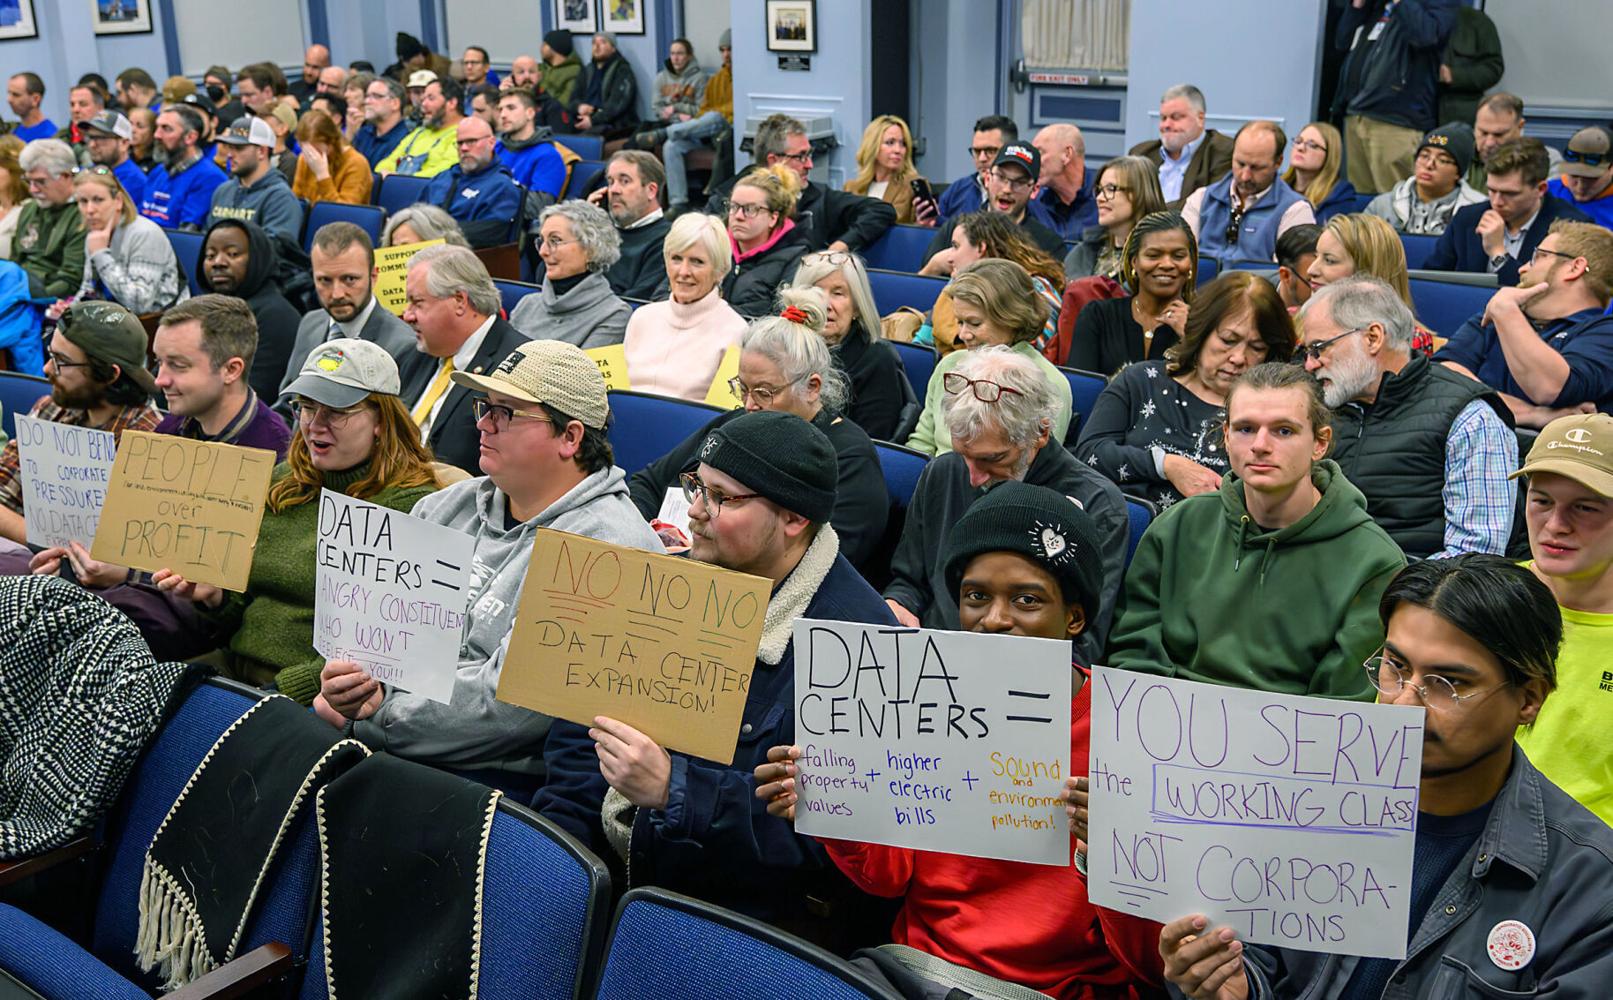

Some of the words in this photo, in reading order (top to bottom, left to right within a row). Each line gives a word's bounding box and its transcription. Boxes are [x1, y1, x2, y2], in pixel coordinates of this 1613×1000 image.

[382, 287, 404, 296] DATA
[20, 418, 44, 446] DO
[53, 425, 82, 457] NOT
[1547, 440, 1604, 456] Champion
[26, 458, 38, 475] TO
[57, 465, 108, 482] CORPORATE
[122, 435, 261, 503] PEOPLE
[158, 500, 202, 520] over
[320, 495, 393, 551] DATA
[121, 519, 246, 576] PROFIT
[318, 538, 423, 590] CENTERS
[321, 573, 372, 615] ANGRY
[379, 593, 465, 631] CONSTITUEN
[553, 540, 622, 600] NO
[640, 562, 691, 616] NO
[702, 579, 758, 629] NO
[536, 619, 638, 665] DATA
[661, 651, 750, 693] CENTER
[809, 627, 959, 704] DATA
[565, 662, 716, 714] EXPANSION!
[800, 693, 989, 740] CENTERS
[1102, 673, 1229, 768] YOU
[1253, 704, 1423, 790] SERVE
[801, 744, 856, 775] falling
[886, 750, 942, 780] higher
[800, 772, 868, 793] property
[889, 781, 952, 803] electric
[989, 790, 1067, 808] environmen
[1012, 776, 1033, 787] and
[1091, 758, 1132, 796] the
[1166, 777, 1325, 828] WORKING
[1339, 791, 1414, 827] CLASS
[805, 798, 853, 816] values
[895, 807, 936, 826] bills
[991, 812, 1056, 831] pollution!
[1113, 828, 1184, 883] NOT
[1226, 907, 1346, 943] TIONS
